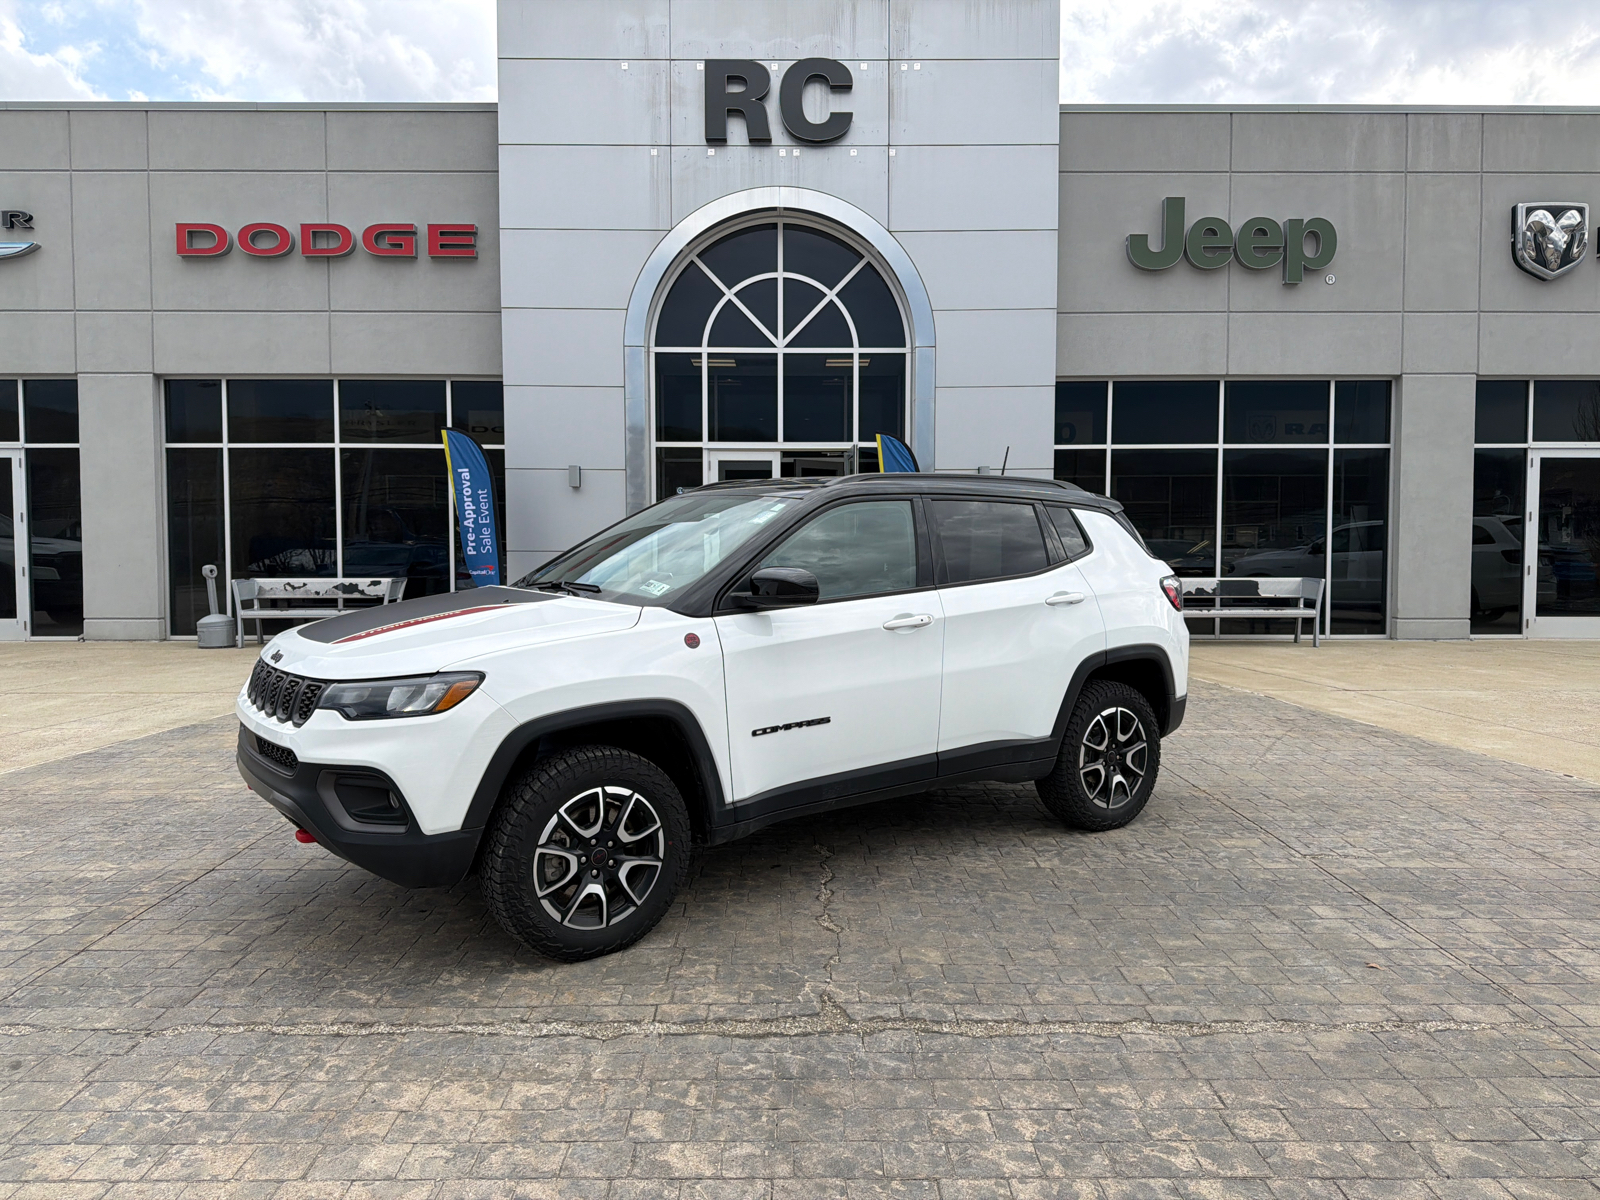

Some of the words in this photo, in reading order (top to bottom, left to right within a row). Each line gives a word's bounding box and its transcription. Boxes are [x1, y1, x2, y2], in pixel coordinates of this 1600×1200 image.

[705, 57, 853, 144] RC
[175, 222, 478, 260] DODGE
[1126, 196, 1338, 285] Jeep
[457, 468, 477, 555] Pre-Approval
[477, 488, 490, 524] Event
[479, 527, 493, 554] Sale
[751, 716, 831, 737] COMPASS
